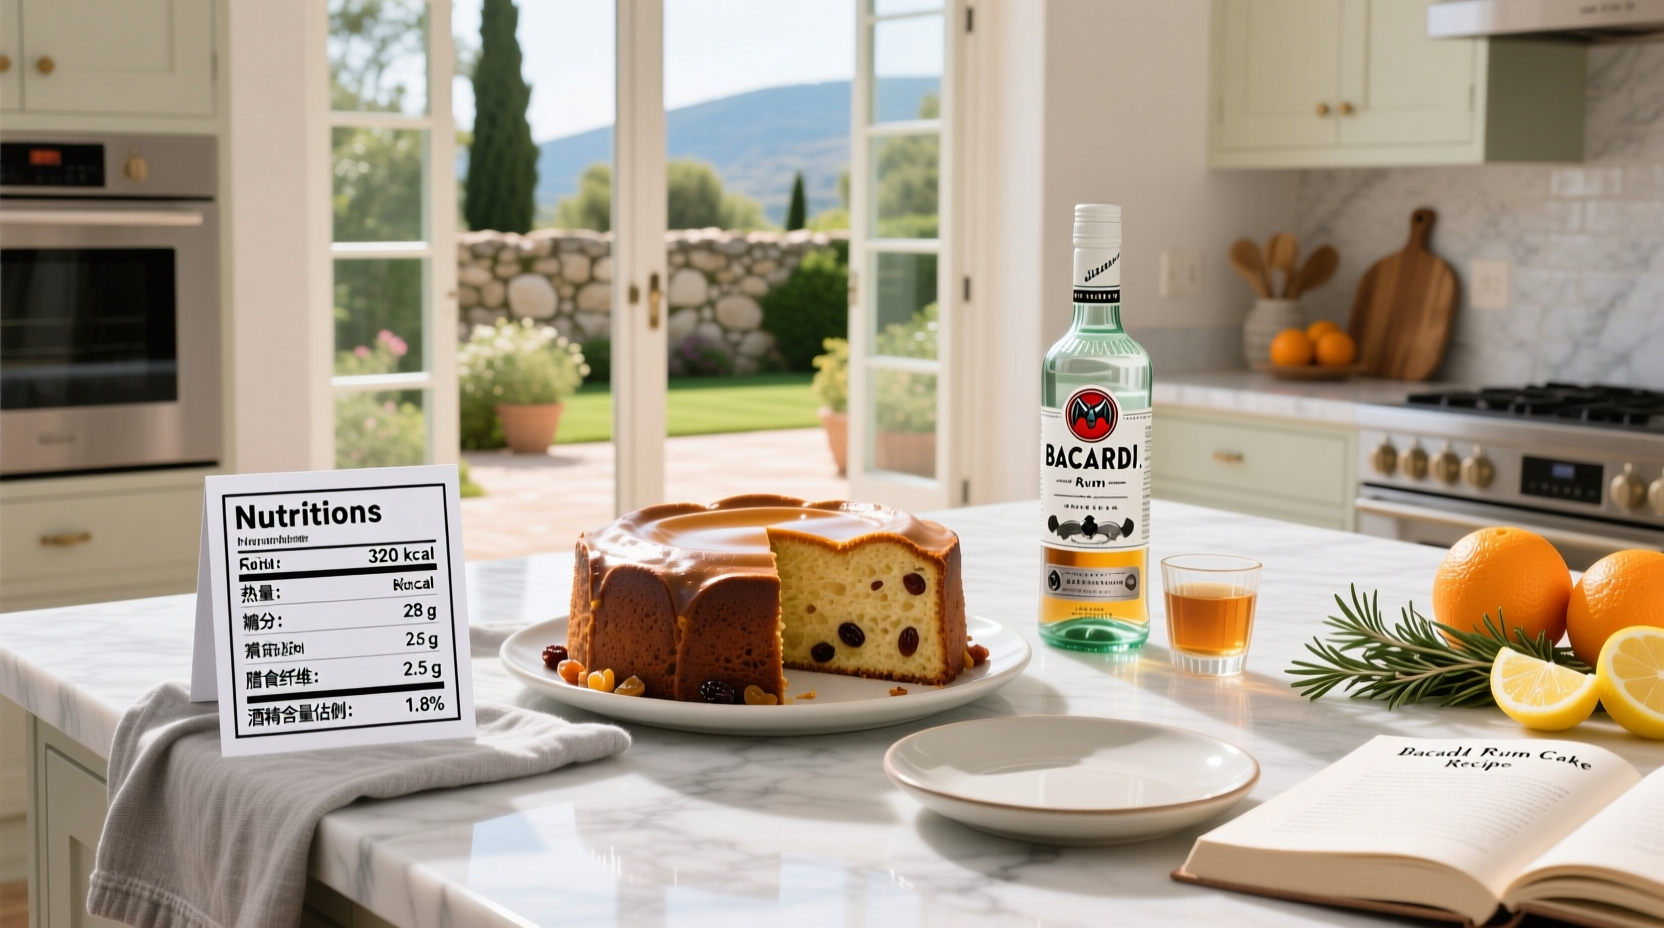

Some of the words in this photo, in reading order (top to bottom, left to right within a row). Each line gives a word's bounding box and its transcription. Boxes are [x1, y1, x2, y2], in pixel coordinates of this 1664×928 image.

[235, 500, 382, 530] Nutritions
[368, 547, 398, 564] 320
[404, 546, 434, 562] kcal
[403, 602, 423, 618] 28
[427, 605, 437, 621] g
[428, 634, 438, 650] g
[403, 660, 428, 677] 2.5
[431, 663, 442, 679] g
[405, 695, 445, 713] 1.8%
[1480, 747, 1531, 758] Rum
[1540, 750, 1592, 771] Cake
